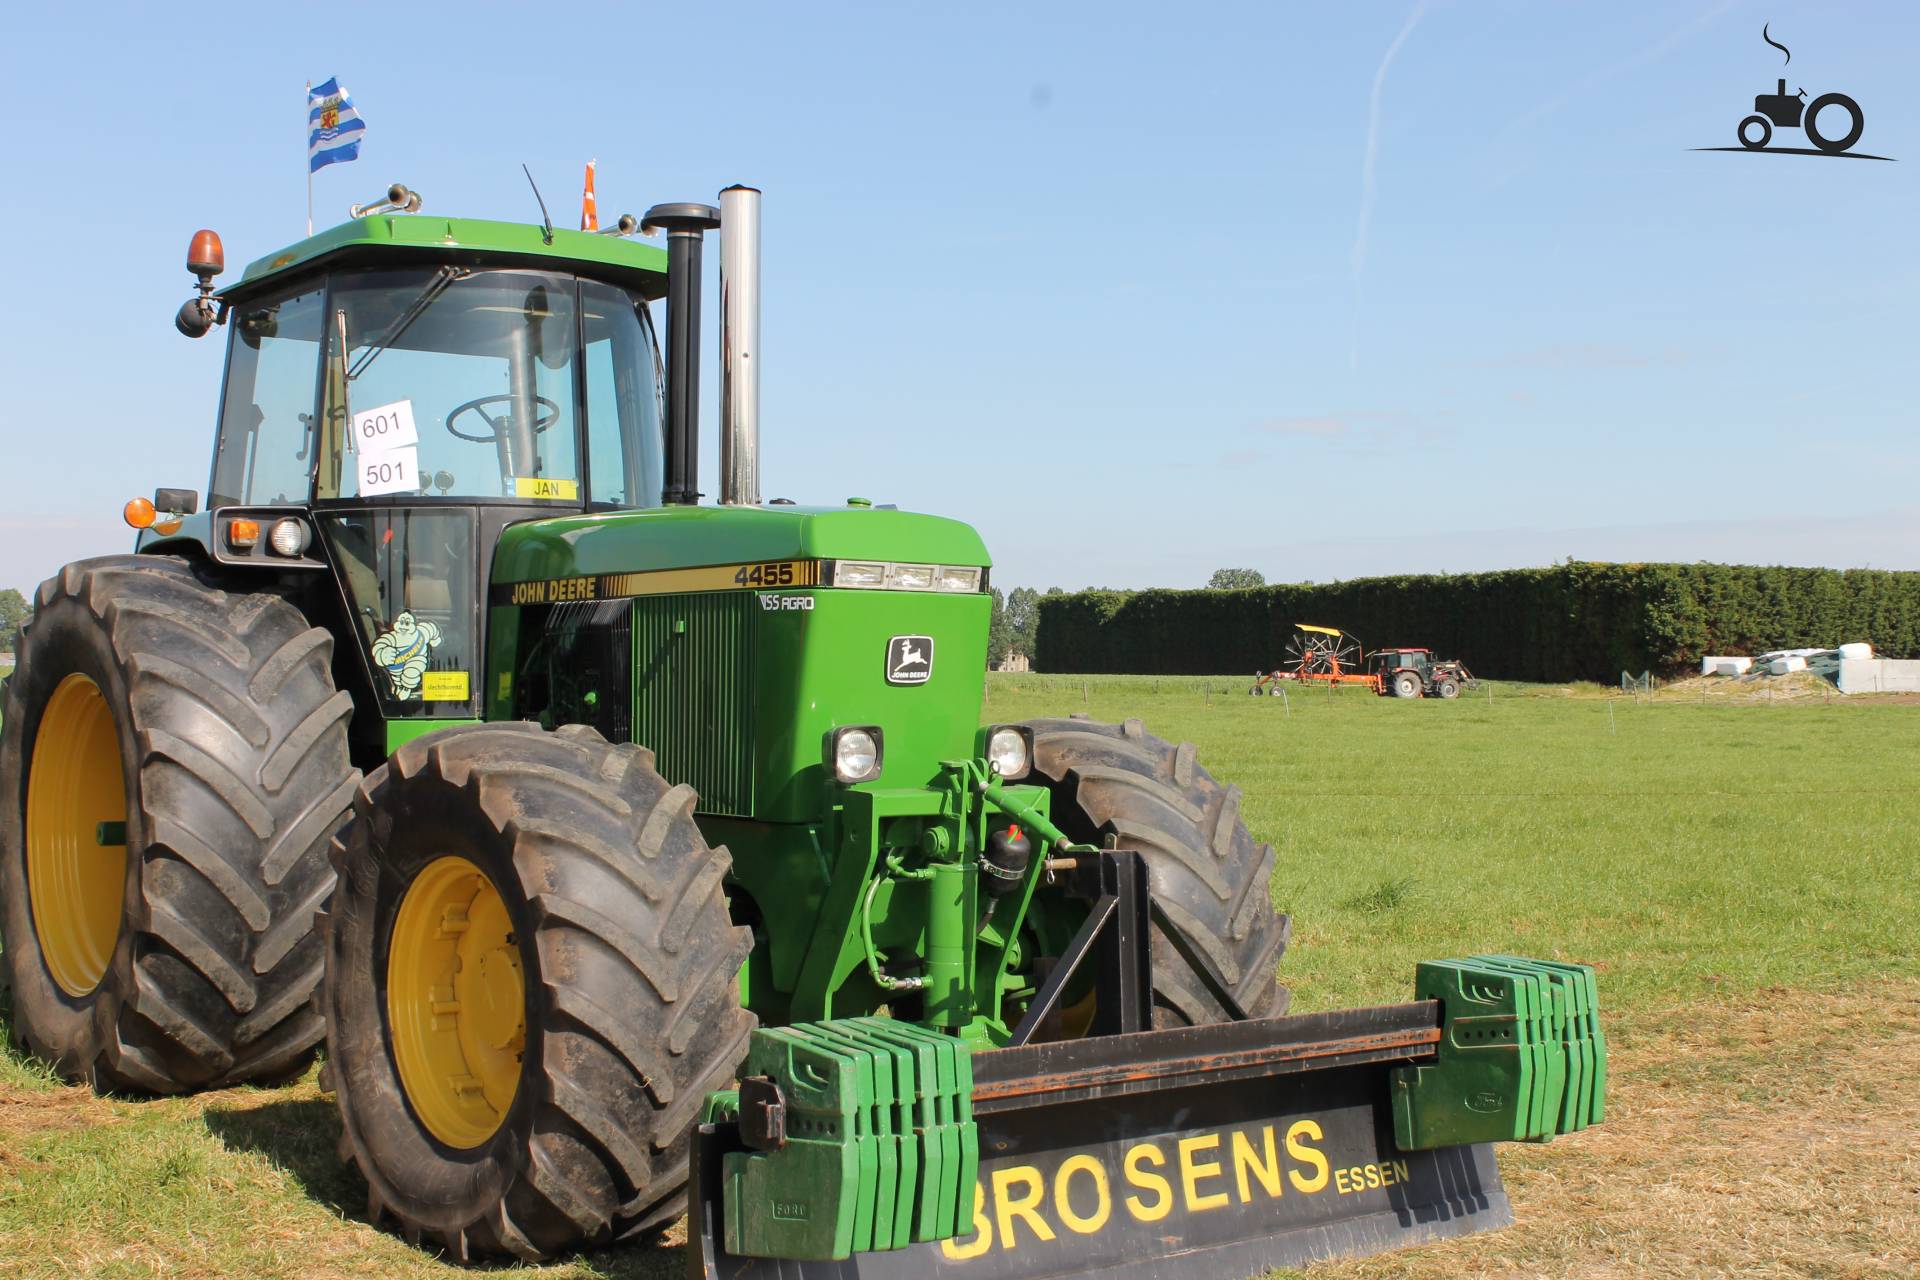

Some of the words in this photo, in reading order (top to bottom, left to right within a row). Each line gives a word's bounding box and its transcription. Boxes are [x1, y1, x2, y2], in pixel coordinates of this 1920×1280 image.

[363, 411, 400, 438] 601
[366, 461, 403, 485] 501
[534, 481, 559, 496] JAN
[735, 563, 794, 587] 4455
[511, 582, 545, 605] JOHN
[549, 577, 597, 600] DEERE
[781, 596, 815, 611] AGRO
[891, 671, 909, 679] JOHN
[1334, 1159, 1410, 1195] ESSEN
